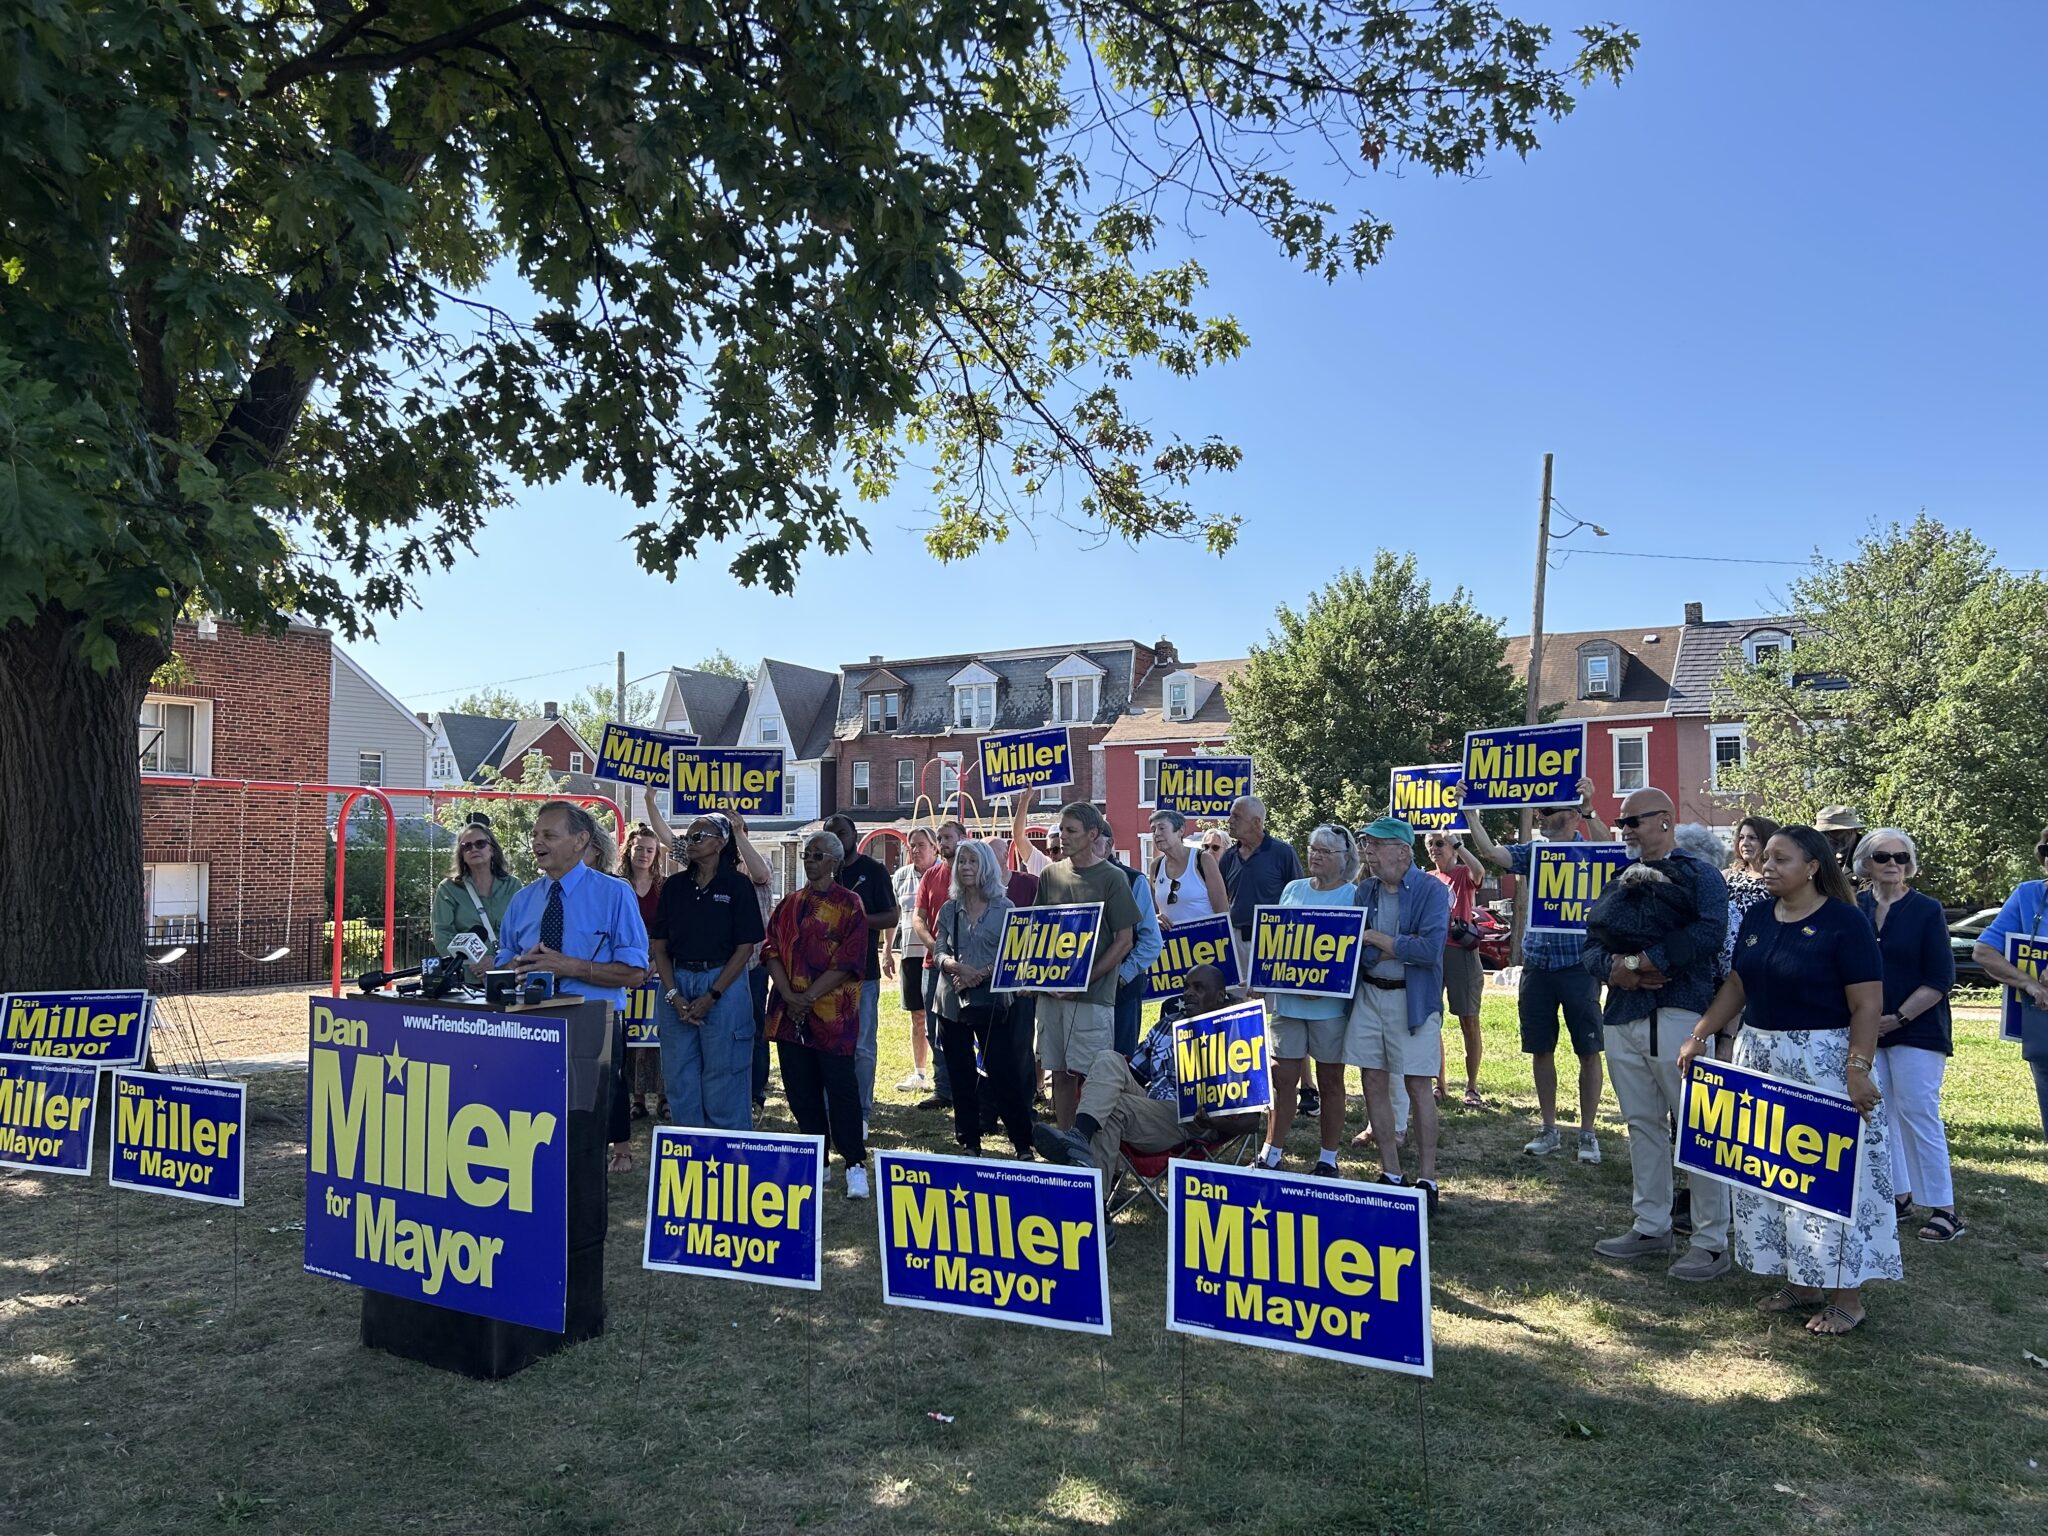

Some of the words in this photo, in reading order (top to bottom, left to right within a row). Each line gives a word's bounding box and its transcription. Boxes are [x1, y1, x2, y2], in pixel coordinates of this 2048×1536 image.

[609, 727, 628, 737] Dan
[1472, 738, 1494, 746] Dan
[604, 735, 670, 770] Mill
[607, 760, 618, 768] for
[678, 753, 699, 761] Dan
[986, 742, 1066, 776] Miller
[1162, 762, 1178, 770] Dan
[1468, 742, 1580, 780] Miller
[678, 759, 780, 792] Miller
[1002, 770, 1052, 787] Mayor
[1160, 768, 1248, 796] Miller
[1396, 774, 1412, 782] Dan
[699, 794, 762, 810] Mayor
[1394, 777, 1458, 810] Mille
[1474, 782, 1487, 790] for
[1488, 780, 1558, 802] Mayor
[1176, 797, 1231, 815] Mayor
[1408, 810, 1458, 828] Mayor
[1541, 850, 1566, 860] Dan
[1538, 857, 1616, 900] Mill
[1010, 915, 1028, 924] Dan
[1260, 913, 1280, 922] Dan
[1544, 902, 1559, 910] for
[1003, 921, 1094, 960] Miller
[1258, 920, 1356, 962] Miller
[1146, 936, 1229, 974] iller
[1004, 963, 1016, 971] for
[1015, 961, 1070, 984] Mayor
[1262, 962, 1272, 971] for
[1272, 962, 1330, 987] Mayor
[13, 999, 39, 1008] Dan
[7, 1004, 138, 1039] Miller
[314, 1006, 368, 1048] Dan
[403, 1013, 560, 1042] www.FriendsofDanMiller.com
[1178, 1029, 1194, 1041] Dan
[30, 1040, 110, 1059] Mayor
[1178, 1030, 1264, 1084] Miller
[120, 1080, 144, 1096] Dan
[1692, 1066, 1724, 1086] Dan
[1184, 1086, 1194, 1096] for
[1196, 1080, 1250, 1107] Mayor
[1762, 1082, 1858, 1113] www.FriendsofDanMiller.com
[118, 1094, 238, 1159] Miller
[311, 1039, 556, 1213] Miller
[1688, 1081, 1854, 1172] Miller
[0, 1127, 62, 1160] Mayor
[662, 1140, 692, 1158] Dan
[726, 1142, 814, 1154] www.FriendsofDanMiller.com
[123, 1148, 138, 1160] for
[140, 1150, 213, 1187] Mayor
[890, 1164, 930, 1185] Dan
[1695, 1134, 1713, 1148] for
[1715, 1140, 1816, 1194] Mayor
[658, 1154, 812, 1230] Miller
[976, 1170, 1092, 1189] www.FriendsofDanMiller.com
[1185, 1175, 1228, 1200] Dan
[1281, 1186, 1416, 1212] www.FriendsofDanMiller.com
[326, 1186, 351, 1218] for
[355, 1192, 504, 1294] Mayor
[891, 1182, 1093, 1271] Miller
[664, 1222, 685, 1236] for
[686, 1222, 780, 1268] Mayor
[1184, 1198, 1416, 1302] Miller
[906, 1253, 930, 1270] for
[934, 1254, 1056, 1308] Mayor
[1196, 1275, 1220, 1296] for
[1226, 1280, 1370, 1340] Mayor
